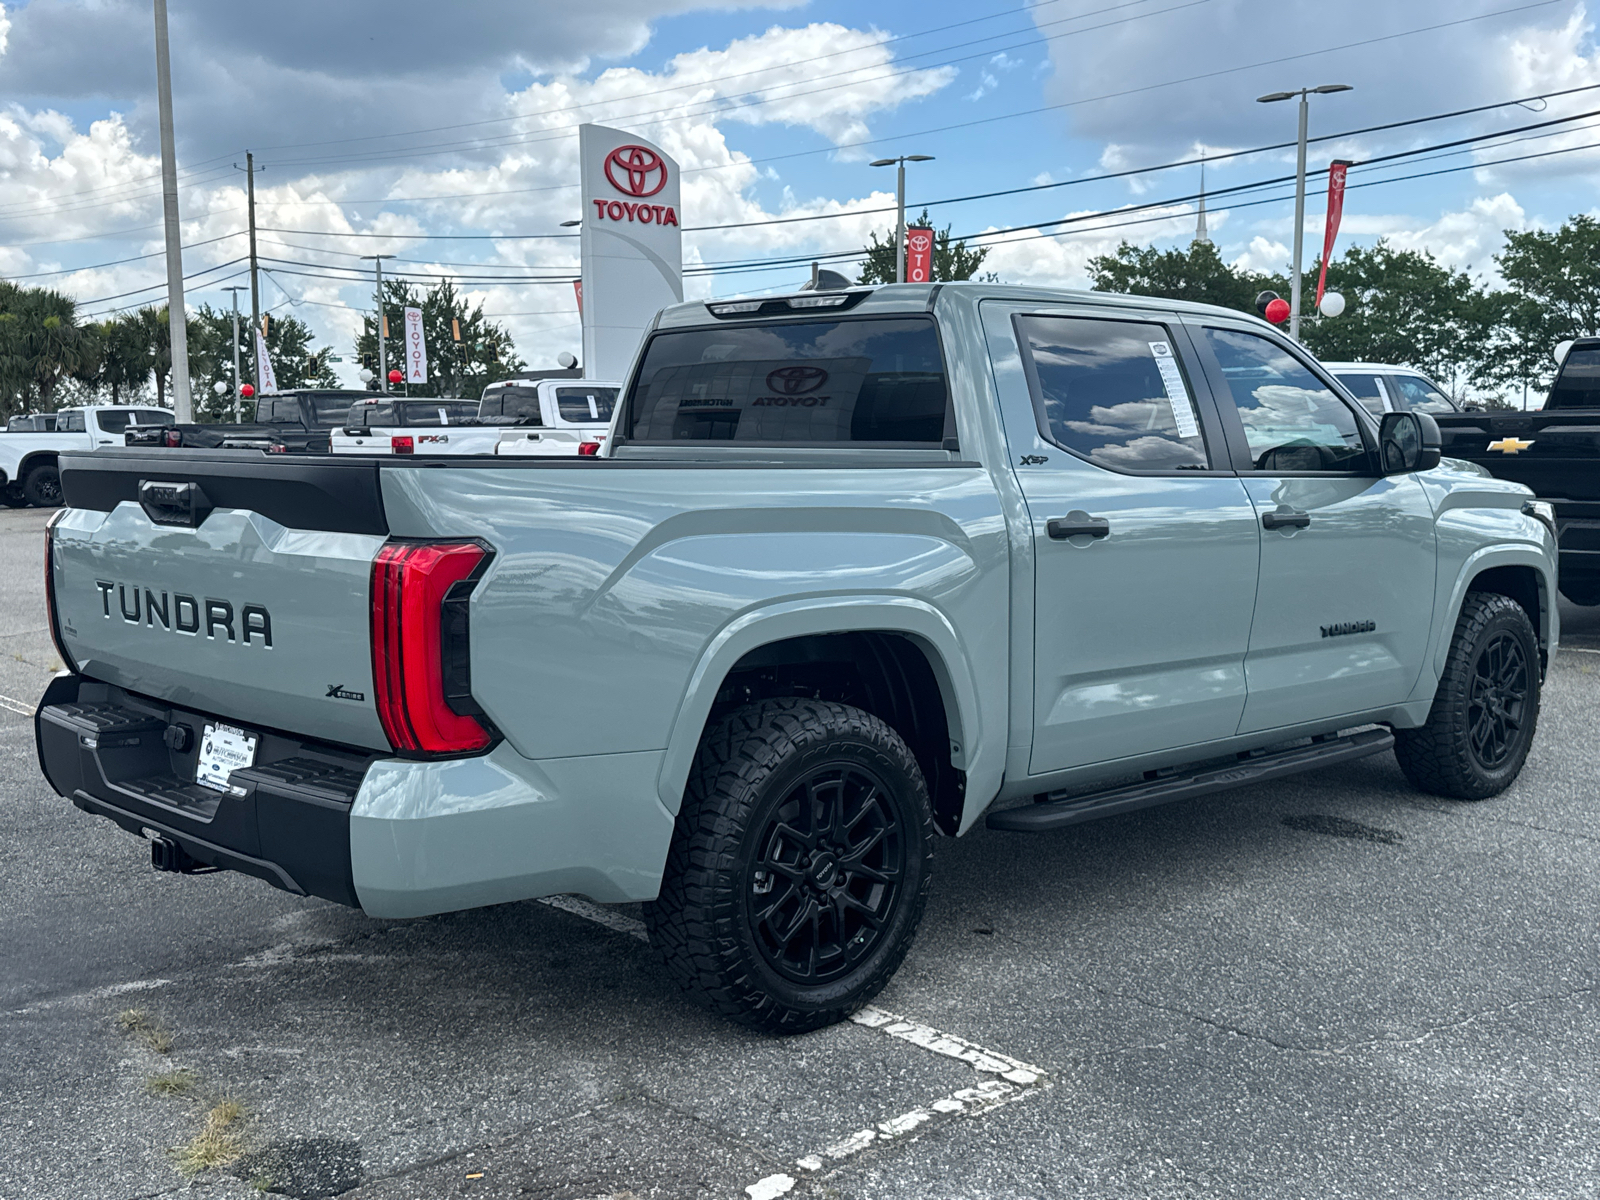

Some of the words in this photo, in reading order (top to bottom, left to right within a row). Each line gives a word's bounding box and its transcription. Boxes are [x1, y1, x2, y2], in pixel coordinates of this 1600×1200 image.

[593, 199, 678, 226] TOYOTA
[411, 323, 422, 378] TOYOTA
[418, 435, 449, 444] FX4
[1019, 454, 1049, 466] XSP
[94, 578, 273, 650] TUNDRA
[1319, 618, 1377, 638] TUNDRA
[815, 861, 833, 881] TOYOTA
